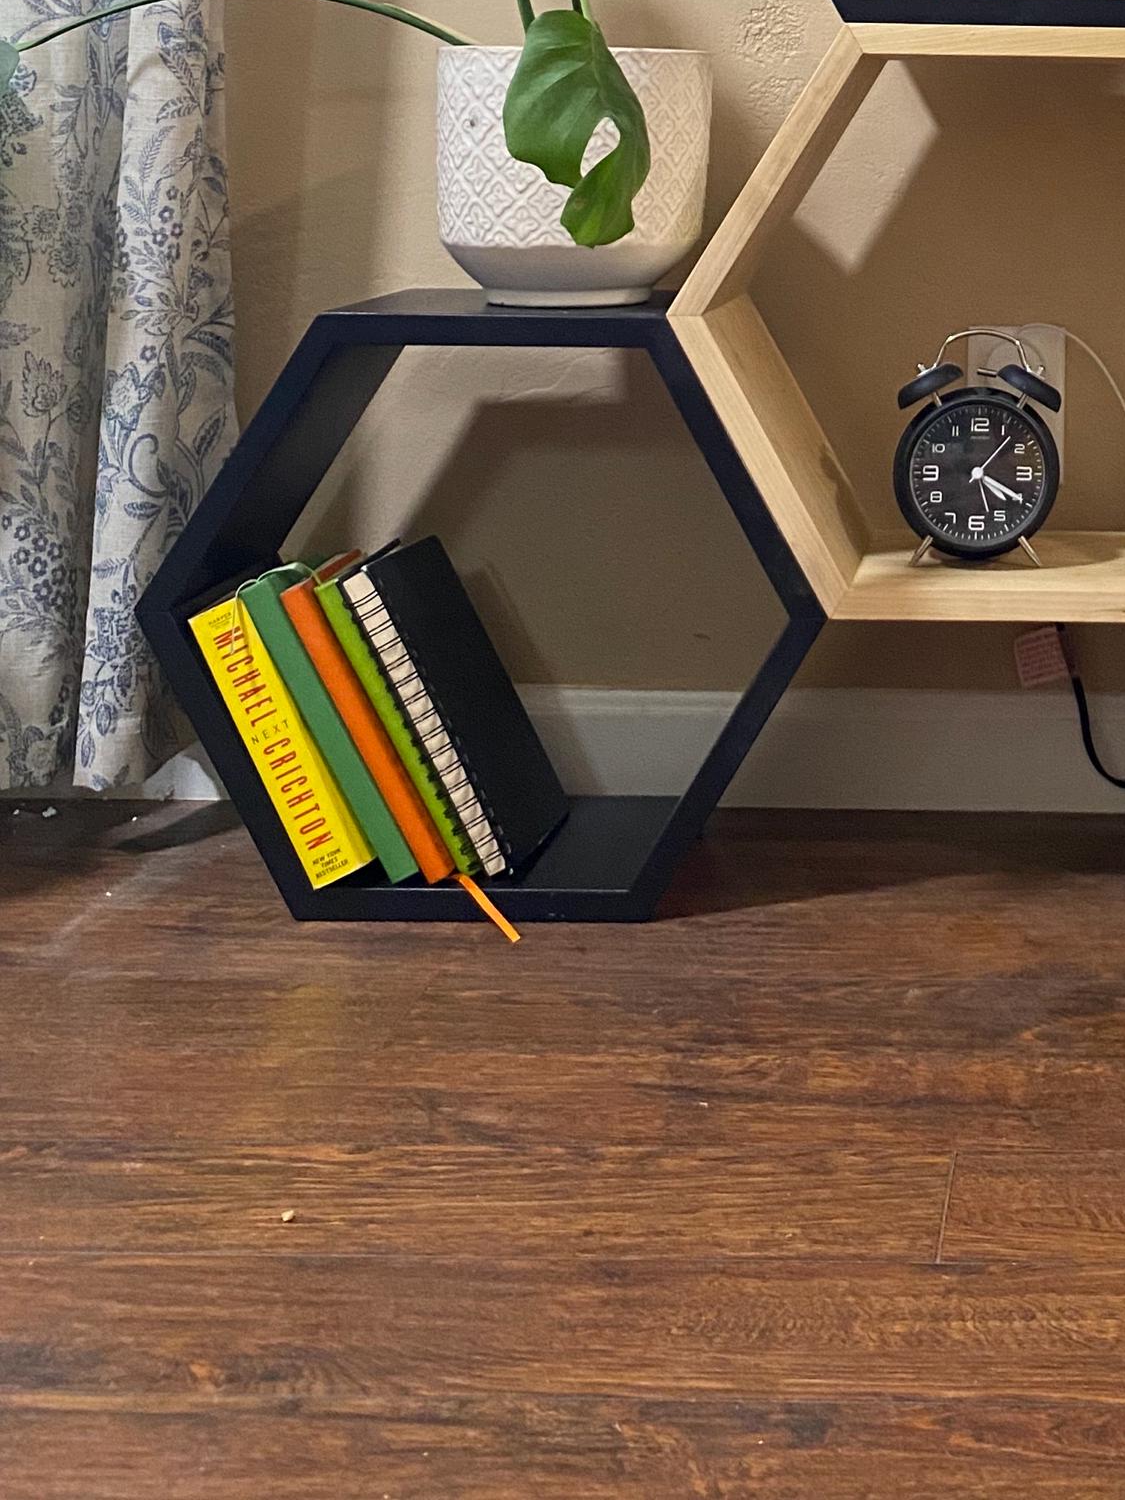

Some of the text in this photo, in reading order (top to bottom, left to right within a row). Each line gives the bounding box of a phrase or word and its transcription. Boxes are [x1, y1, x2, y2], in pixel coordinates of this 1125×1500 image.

[951, 425, 959, 437] 11
[970, 417, 990, 432] 12
[932, 443, 945, 453] 10
[1014, 443, 1025, 454] 2
[922, 465, 939, 481] 9
[1015, 466, 1032, 481] 3
[930, 491, 942, 503] 8
[944, 512, 956, 524] 7
[967, 515, 985, 531] 6
[993, 510, 1006, 521] 5
[213, 625, 277, 728] MICHAEL
[251, 719, 289, 745] NEXT
[263, 737, 334, 851] CRICHTON
